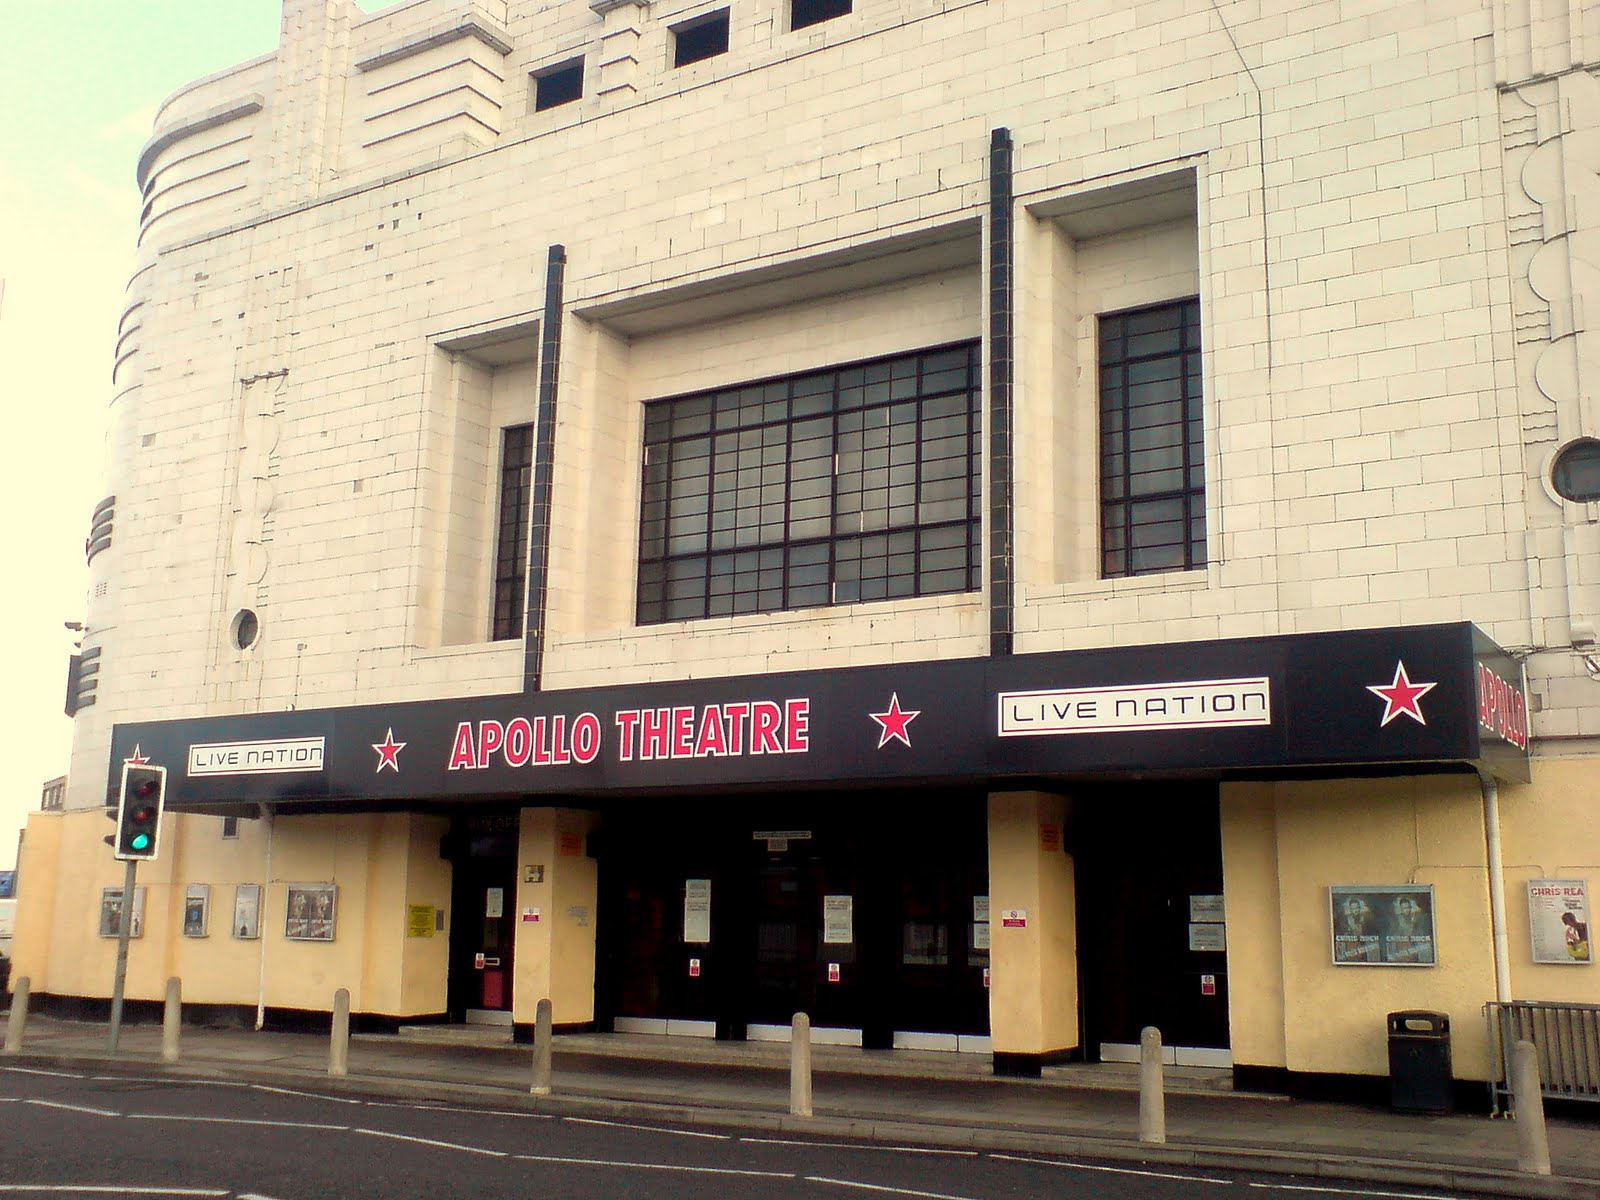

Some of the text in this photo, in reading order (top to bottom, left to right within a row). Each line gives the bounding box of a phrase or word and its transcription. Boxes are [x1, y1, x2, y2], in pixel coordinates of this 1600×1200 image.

[1013, 691, 1266, 722] LIVE NATION
[1478, 661, 1526, 751] APOLLO
[448, 697, 811, 771] APOLLO THEATRE
[196, 746, 323, 768] LIVE NATION
[1531, 887, 1585, 897] CHRIS REA
